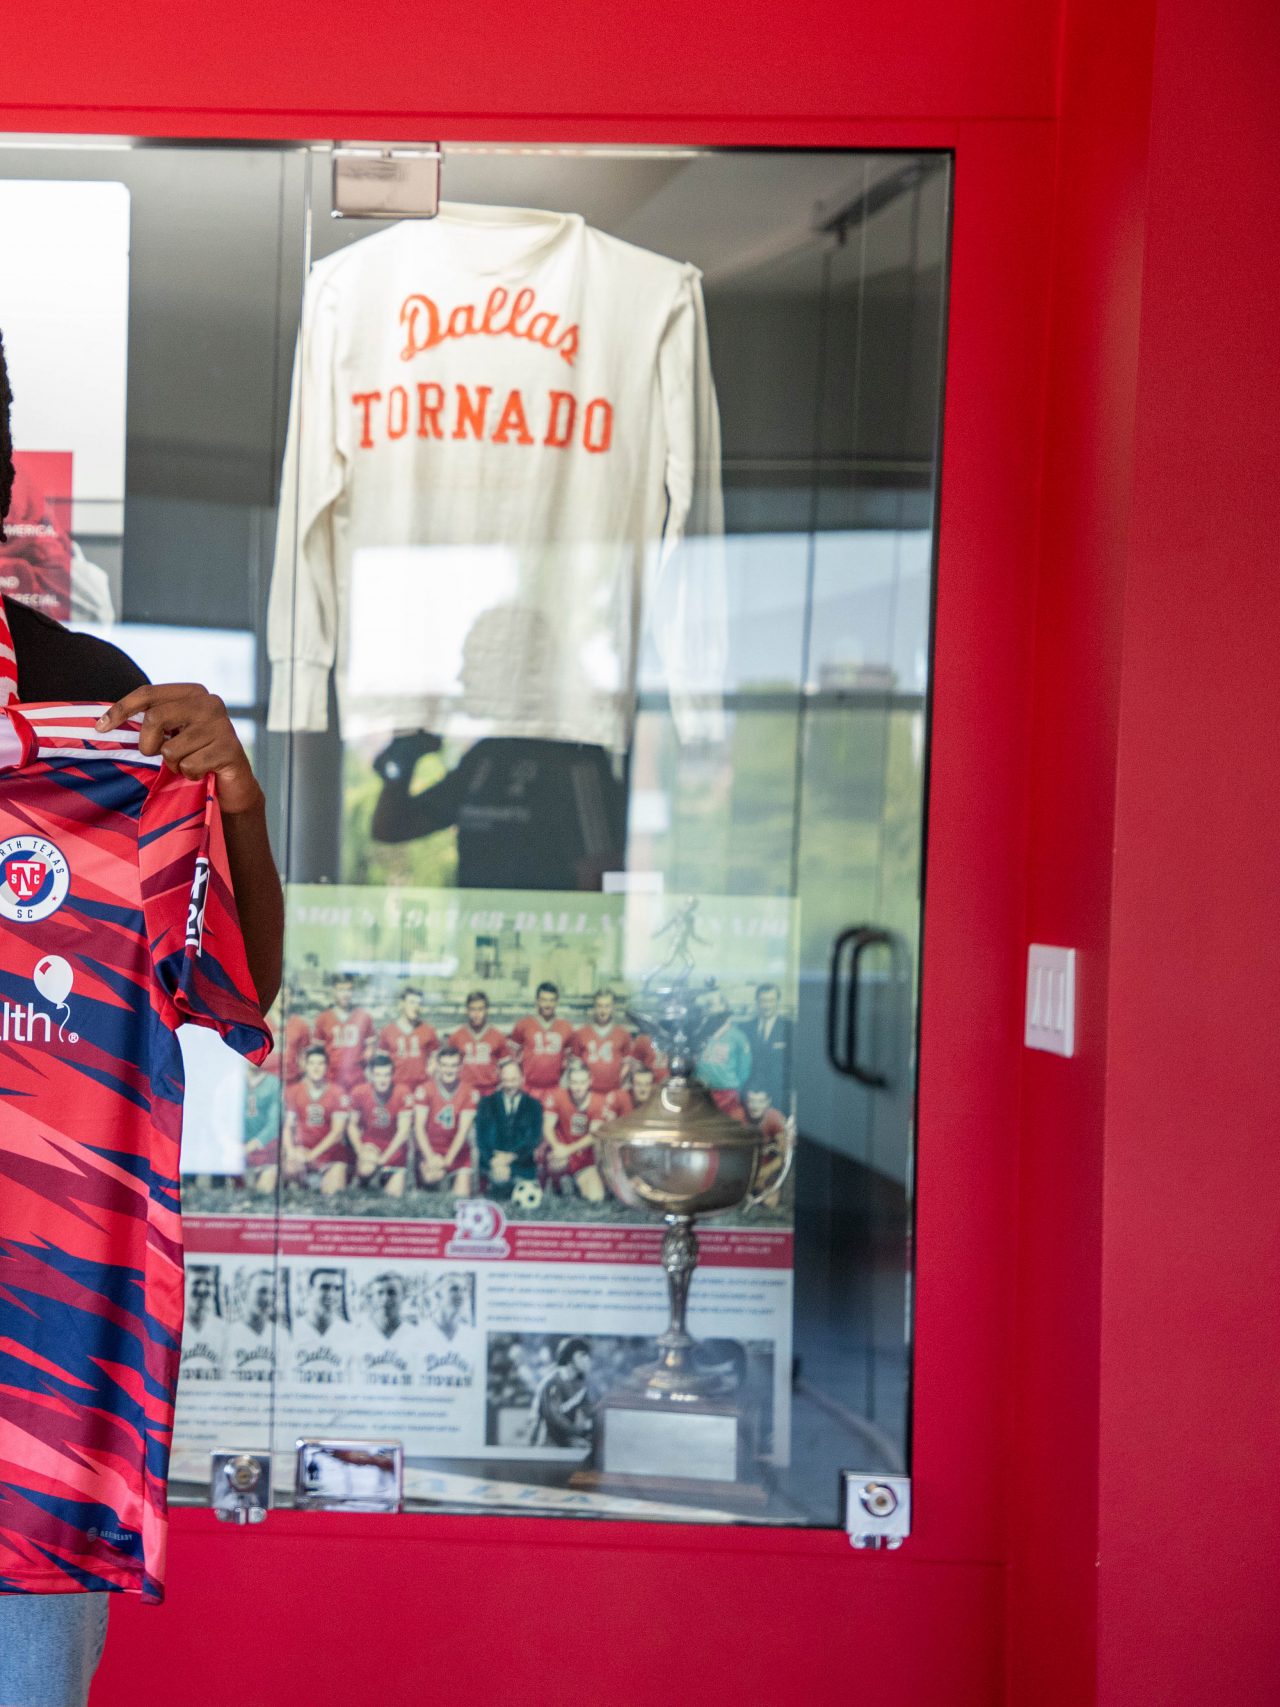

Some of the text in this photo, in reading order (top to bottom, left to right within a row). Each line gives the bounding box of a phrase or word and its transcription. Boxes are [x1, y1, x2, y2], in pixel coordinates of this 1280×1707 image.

[399, 286, 580, 367] Dallas
[351, 382, 615, 454] TORNADO
[32, 841, 65, 874] TEXAS
[397, 1036, 422, 1058] 11
[588, 1040, 613, 1064] 14
[436, 1104, 455, 1130] 4
